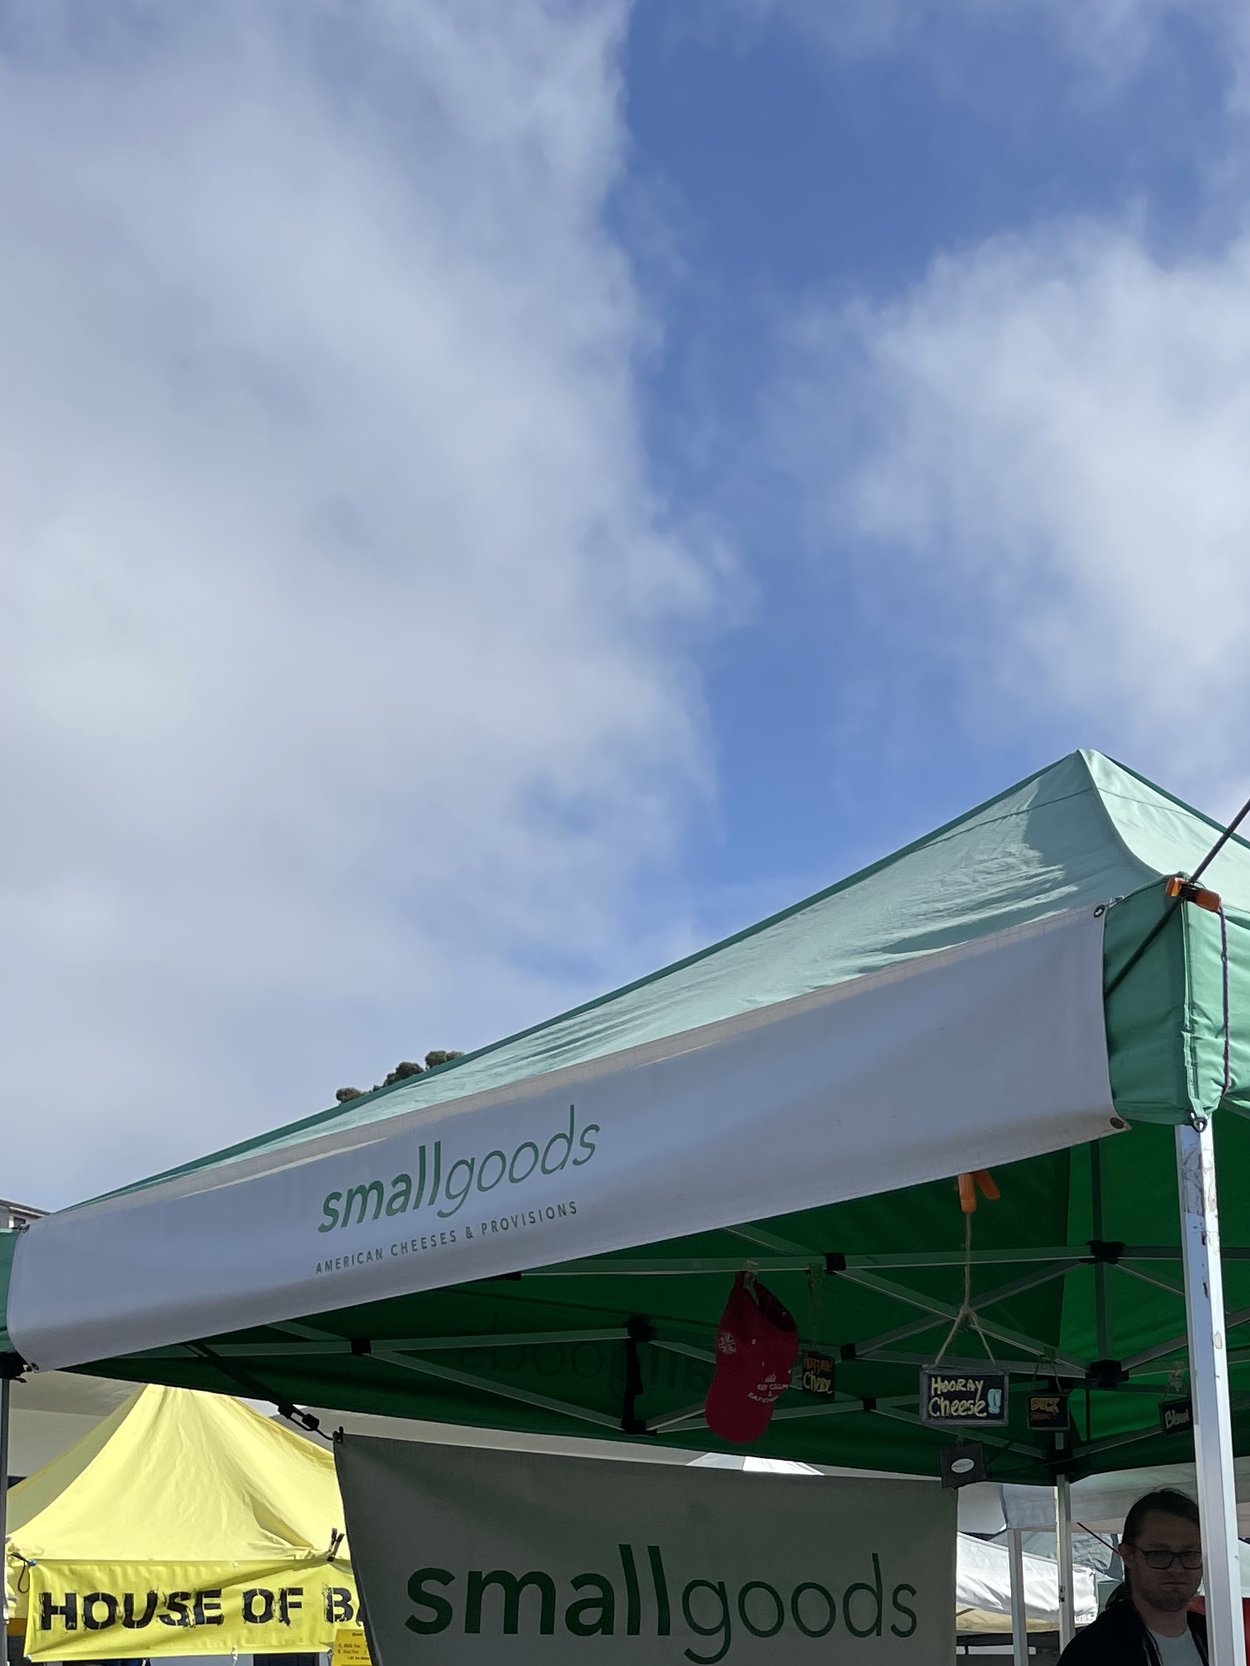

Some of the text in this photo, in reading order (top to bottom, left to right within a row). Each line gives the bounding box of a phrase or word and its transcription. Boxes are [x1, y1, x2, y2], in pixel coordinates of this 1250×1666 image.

[317, 1104, 601, 1234] smallgoods
[315, 1200, 578, 1275] AMERICAN CHEESES & PROVISIONS
[930, 1376, 984, 1404] HOORAY
[38, 1587, 225, 1633] HOUSE
[241, 1586, 305, 1630] OF
[404, 1543, 918, 1666] smallgoods
